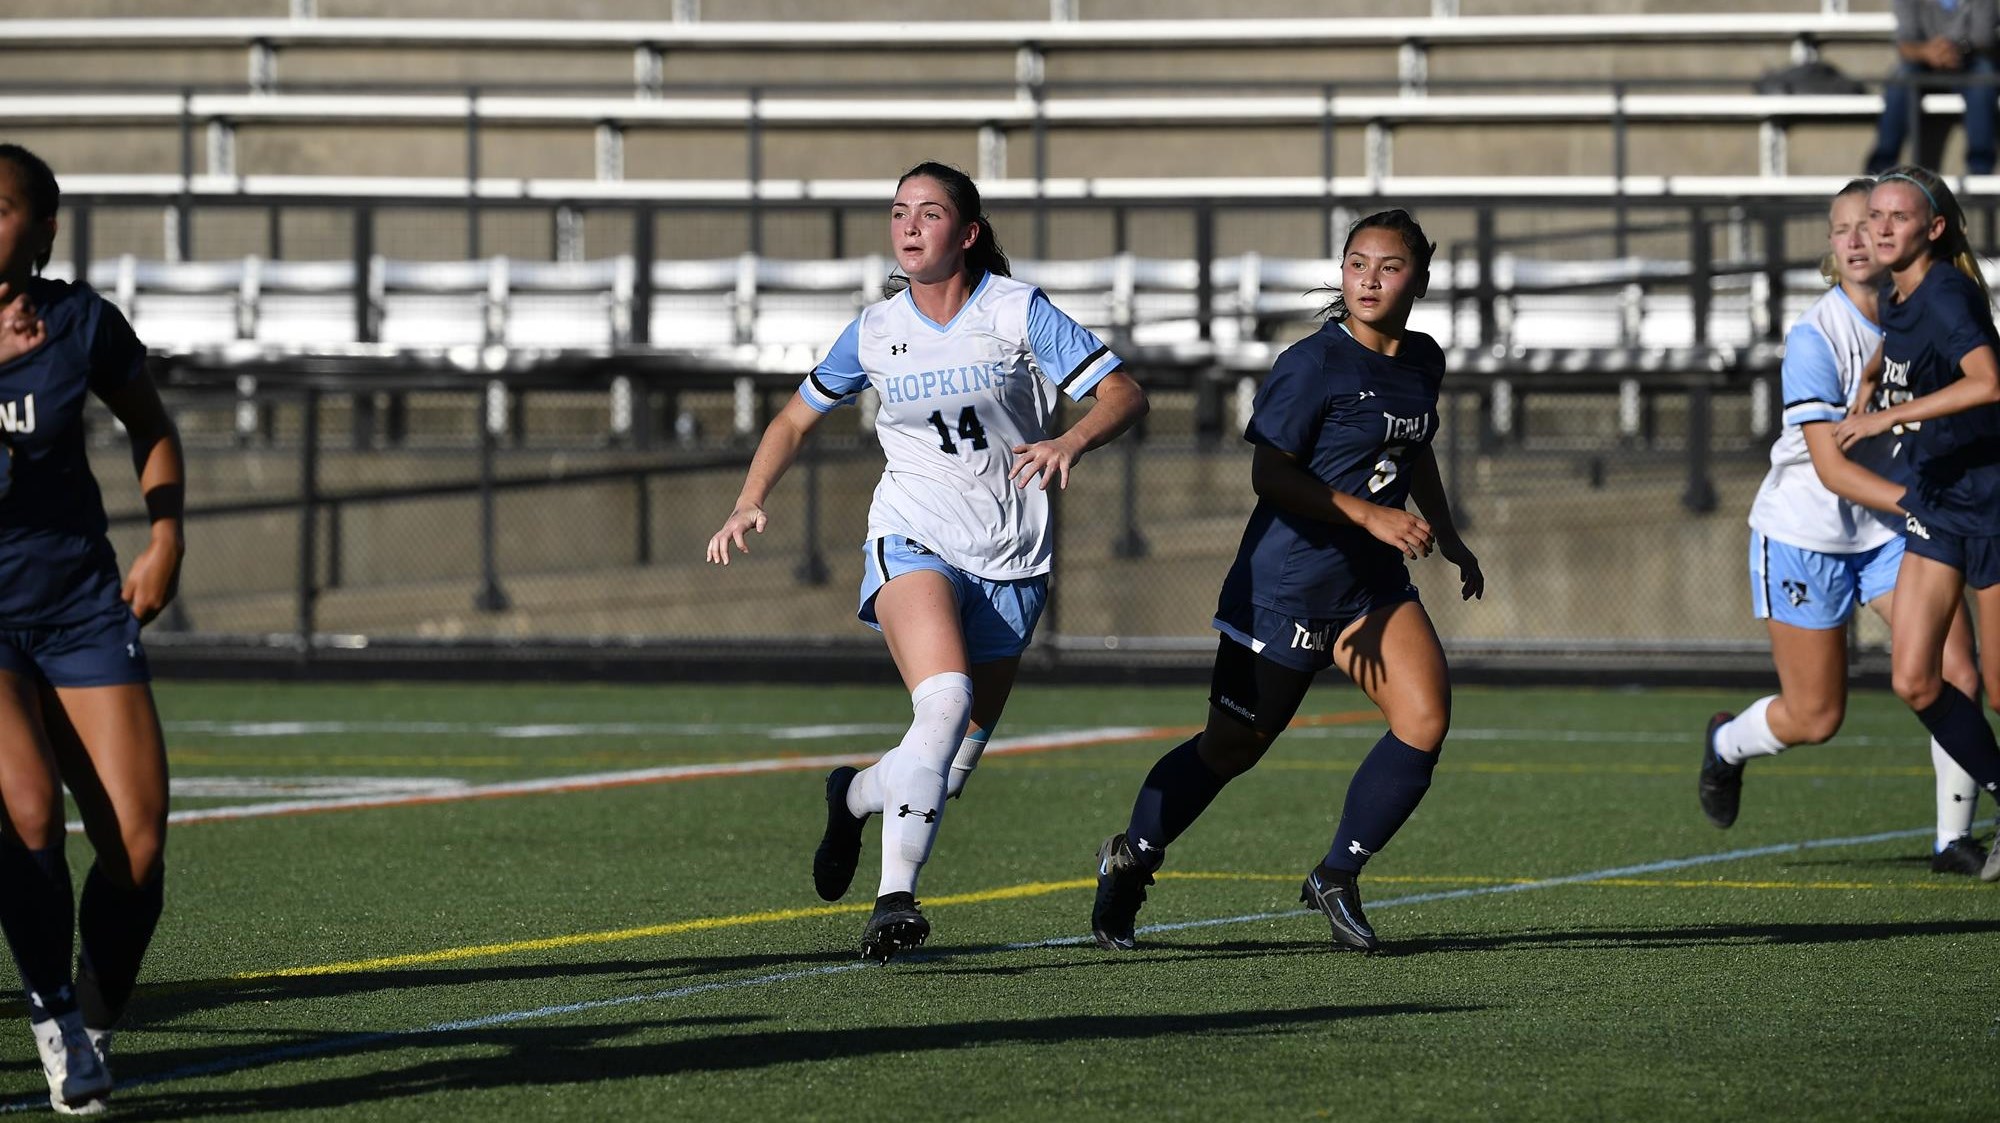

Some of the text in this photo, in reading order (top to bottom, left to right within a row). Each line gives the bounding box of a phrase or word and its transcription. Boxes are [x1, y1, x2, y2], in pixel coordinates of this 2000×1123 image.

[885, 361, 1006, 403] HOPKINS
[926, 404, 990, 455] 14
[1383, 411, 1429, 443] TCNJ
[1367, 447, 1407, 494] 5
[1291, 621, 1330, 652] TCNJ
